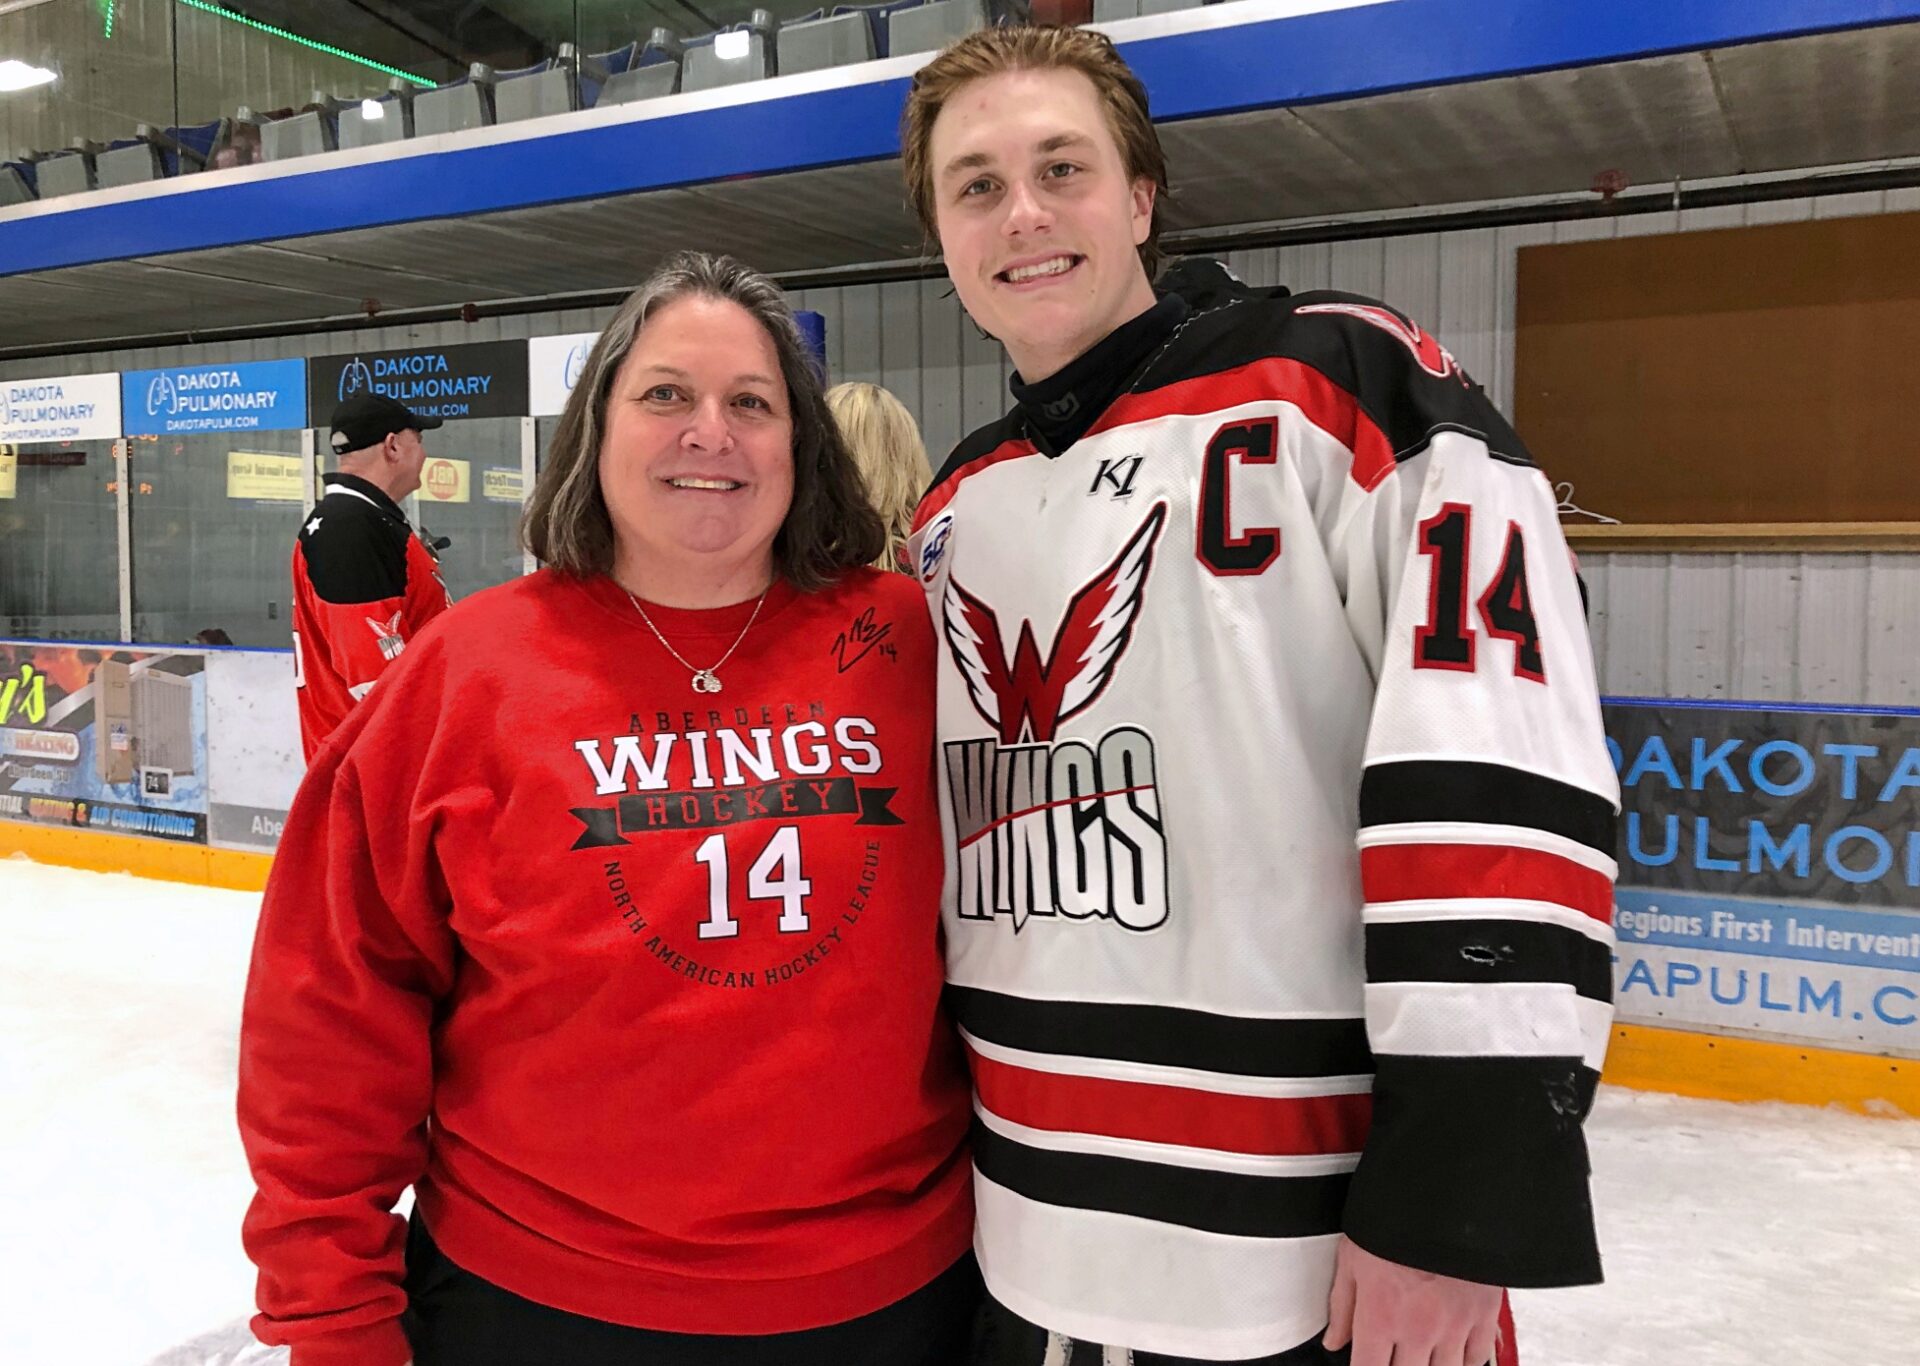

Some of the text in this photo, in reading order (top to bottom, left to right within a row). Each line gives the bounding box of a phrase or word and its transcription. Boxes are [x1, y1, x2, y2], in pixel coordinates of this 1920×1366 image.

[177, 371, 241, 391] DAKOTA
[374, 355, 448, 377] DAKOTA
[11, 386, 64, 403] DAKOTA
[178, 391, 277, 412] PULMONARY
[375, 376, 491, 399] PULMONARY
[11, 404, 95, 423] PULMONARY
[166, 416, 258, 431] DAKOTAPULM.COM
[1195, 416, 1281, 577] C
[1413, 502, 1548, 686] 14
[629, 701, 825, 732] ABERDEEN
[574, 716, 884, 796] WINGS
[648, 781, 834, 826] HOCKEY
[943, 726, 1168, 934] WINGS
[694, 825, 813, 941] 14
[604, 838, 882, 990] NORTH AMERICAN HOCKEY LEAGUE
[1711, 911, 1773, 943] First
